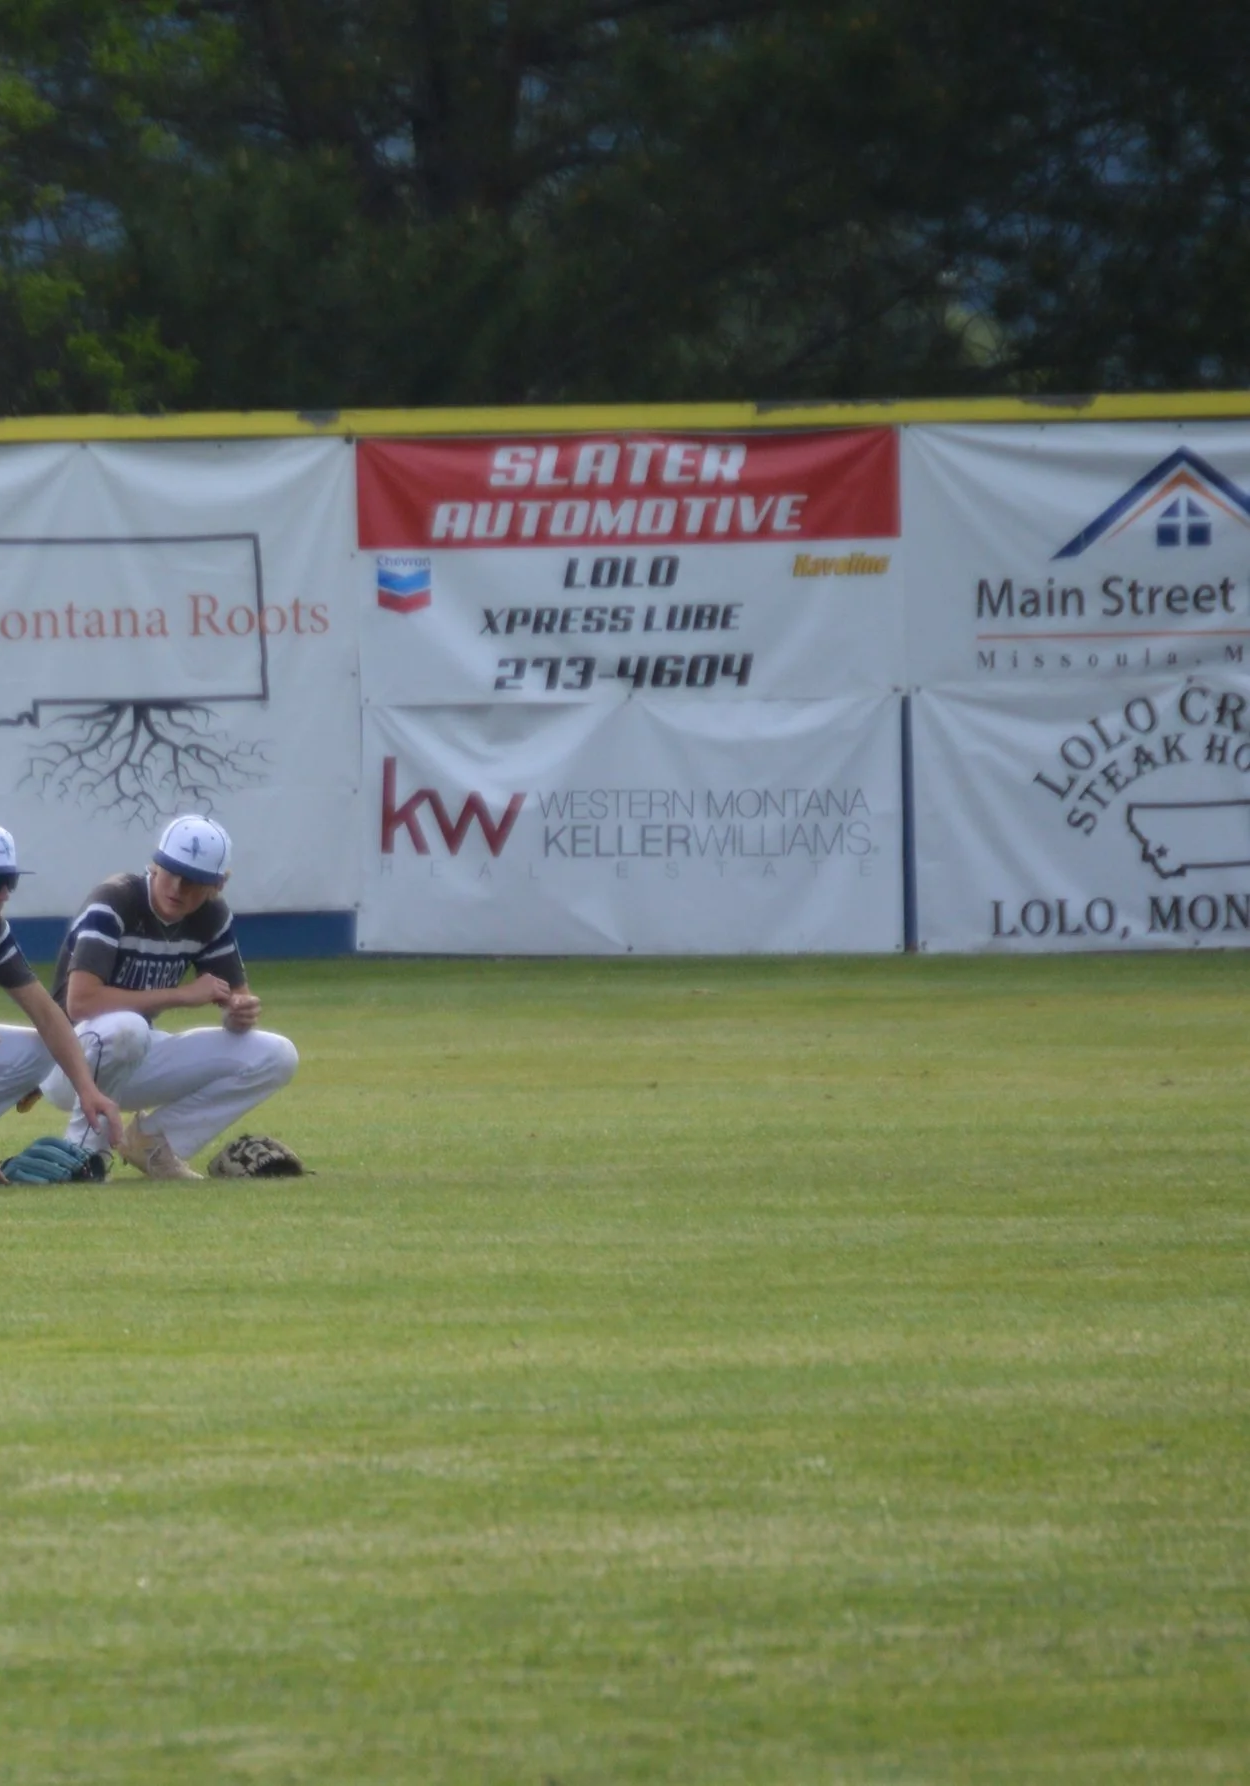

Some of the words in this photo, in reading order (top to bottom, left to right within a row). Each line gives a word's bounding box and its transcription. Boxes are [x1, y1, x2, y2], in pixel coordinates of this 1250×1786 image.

[489, 443, 748, 488] SLATER
[430, 493, 807, 541] AUTOMOTIVE
[563, 555, 680, 589] LOLO
[189, 594, 330, 637] Roots
[976, 577, 1085, 618] Main
[1102, 575, 1236, 616] Street
[479, 606, 636, 635] XPRESS
[643, 603, 744, 631] LUBE
[493, 654, 754, 692] 273-4604
[1033, 696, 1159, 800] LOLO
[1179, 686, 1250, 736] CR
[537, 790, 695, 820] WESTERN
[705, 788, 871, 818] MONTANA
[1067, 733, 1192, 836] STEAK
[380, 861, 539, 880] REAL
[616, 860, 872, 879] ESTATE
[991, 897, 1131, 940] LOLO,
[1149, 893, 1250, 933] MON
